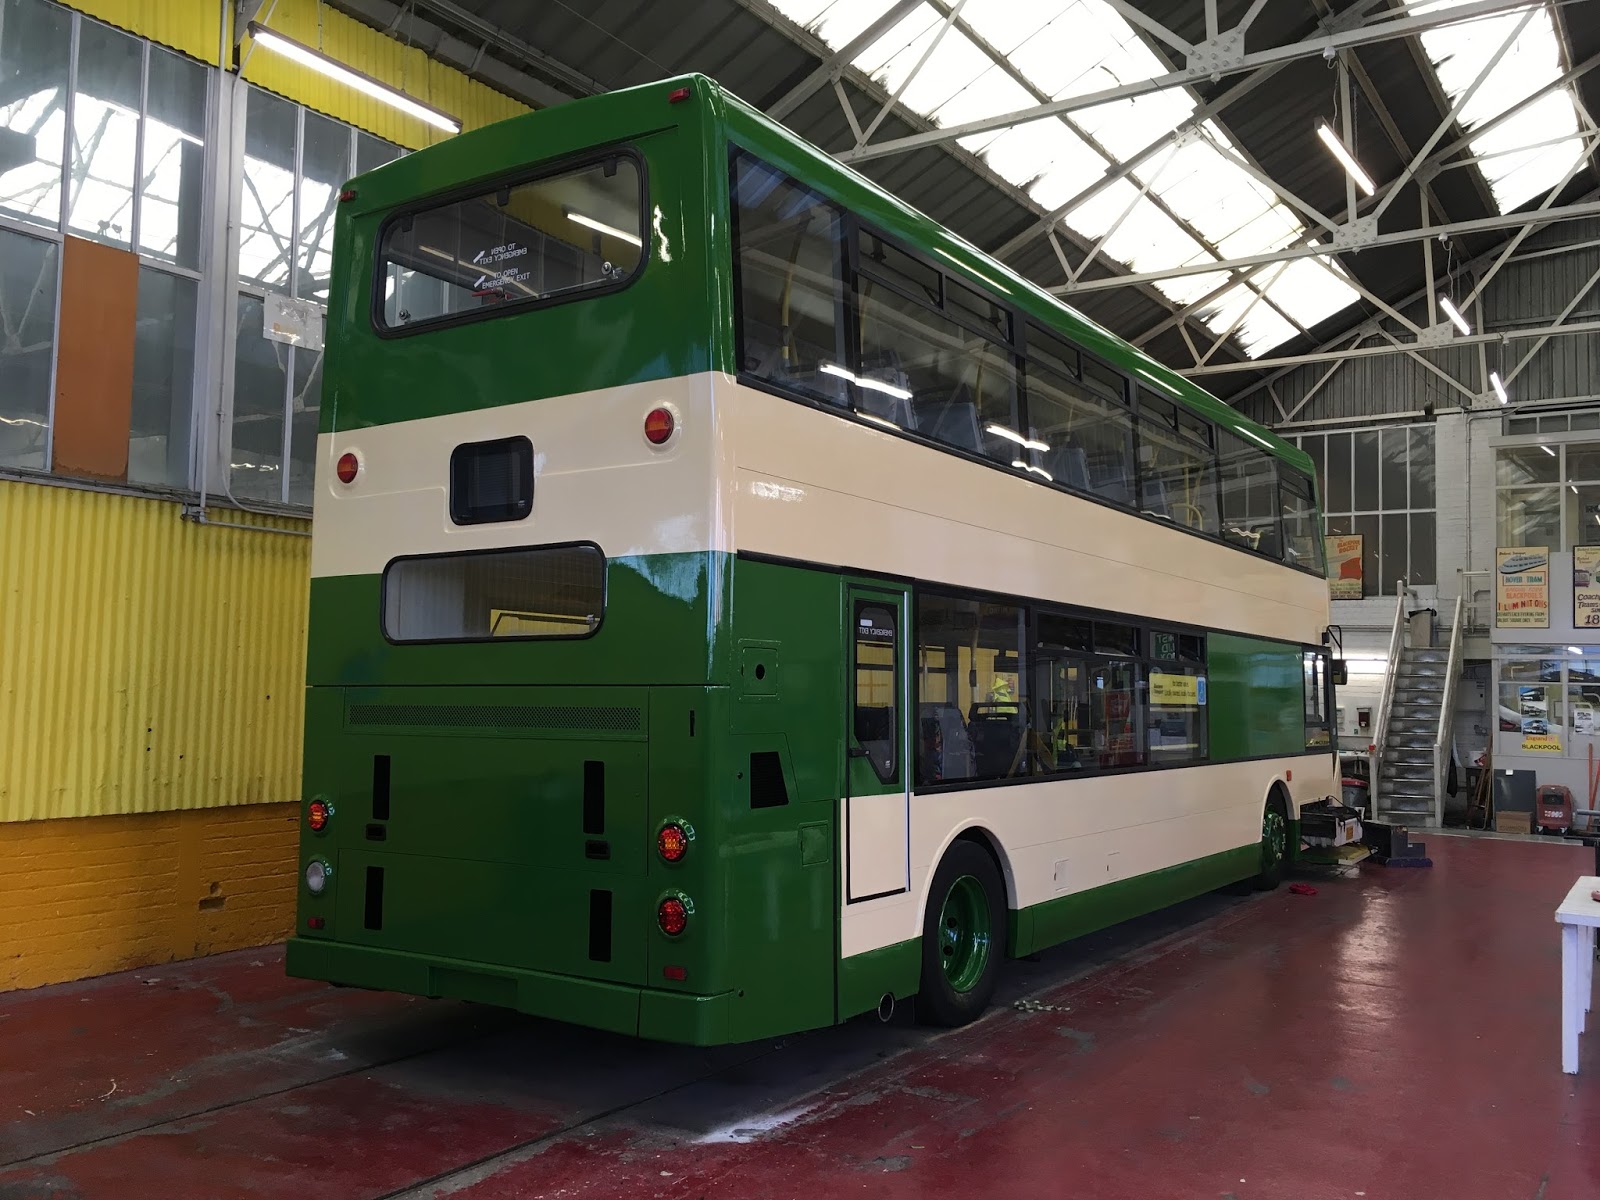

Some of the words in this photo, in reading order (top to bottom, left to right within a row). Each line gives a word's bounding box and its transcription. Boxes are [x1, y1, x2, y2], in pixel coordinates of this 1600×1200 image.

[503, 268, 519, 277] OPEN
[481, 275, 515, 289] EMERGENCY
[516, 272, 531, 282] EXIT
[1526, 575, 1543, 583] TRAM
[1521, 743, 1561, 751] BLACKPOOL
